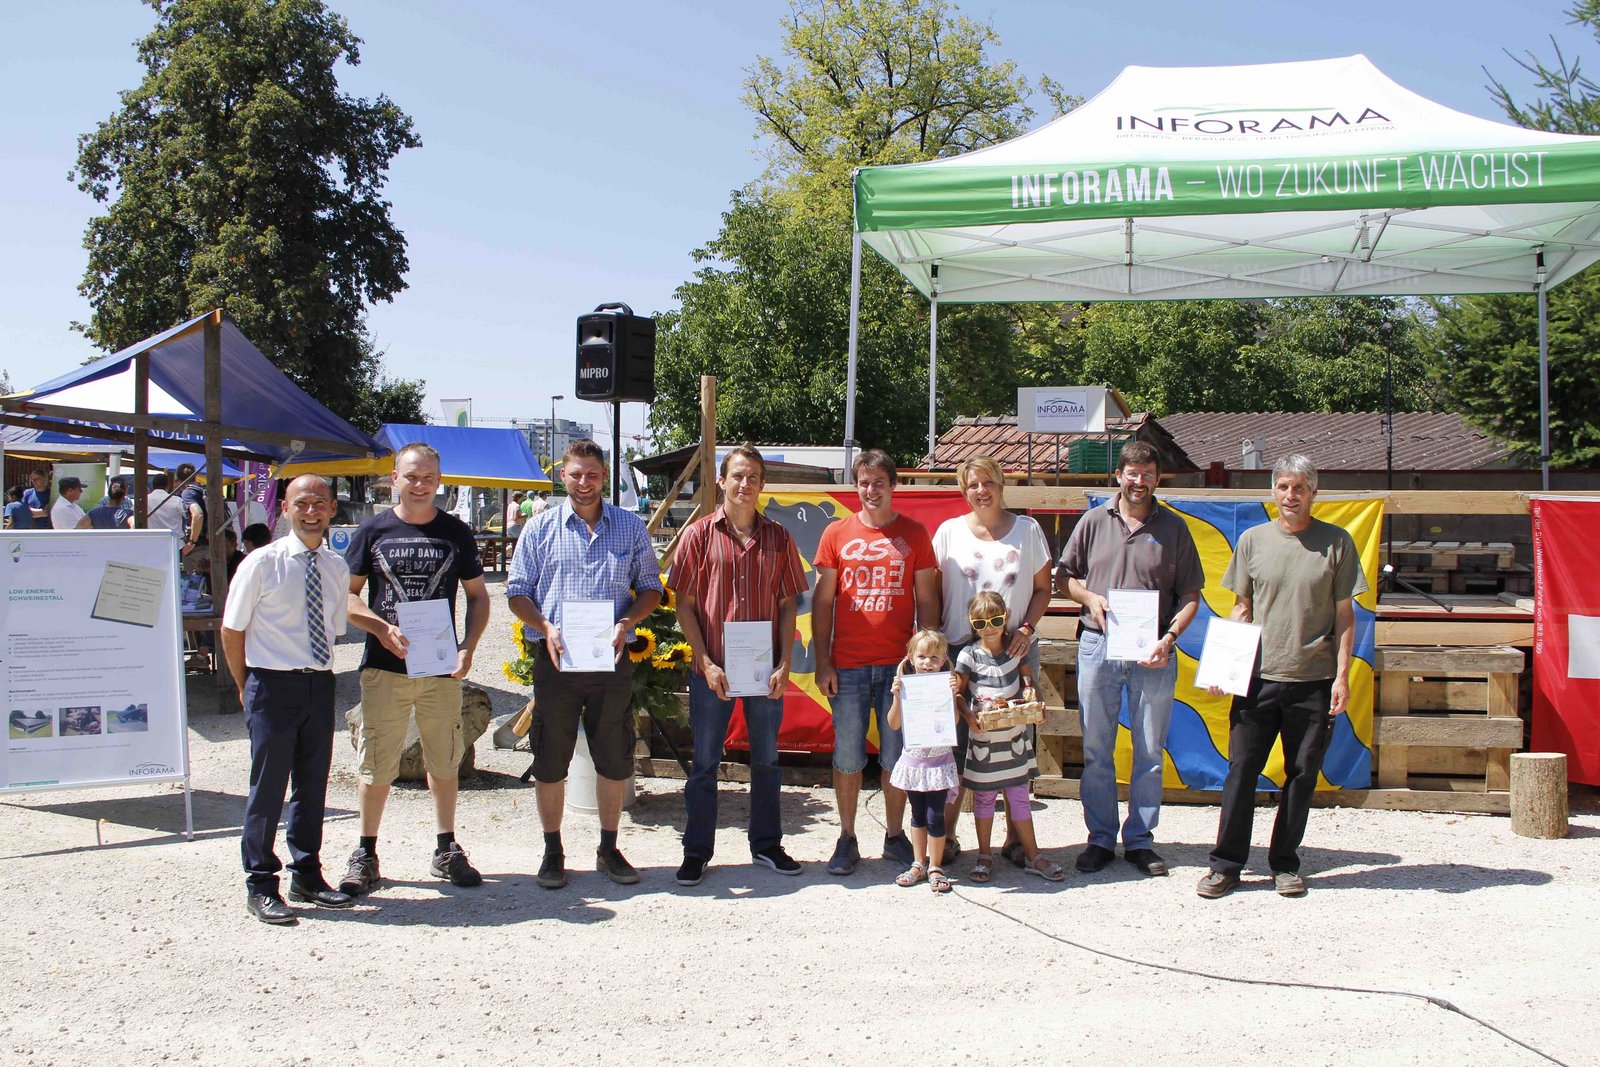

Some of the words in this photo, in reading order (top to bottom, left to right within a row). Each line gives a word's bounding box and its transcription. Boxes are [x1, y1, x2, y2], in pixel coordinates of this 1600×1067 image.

[1116, 107, 1391, 134] INFORAMA
[1011, 167, 1174, 208] INFORAMA
[1216, 164, 1264, 198] WO
[1274, 157, 1408, 198] ZUKUNFT
[1419, 151, 1550, 191] WÄCHST
[1037, 405, 1085, 414] INFORAMA
[389, 548, 415, 558] CAMP
[418, 548, 443, 558] DAVID
[840, 538, 892, 561] QS
[406, 588, 424, 597] SEAS
[129, 767, 176, 776] INFORAMA
